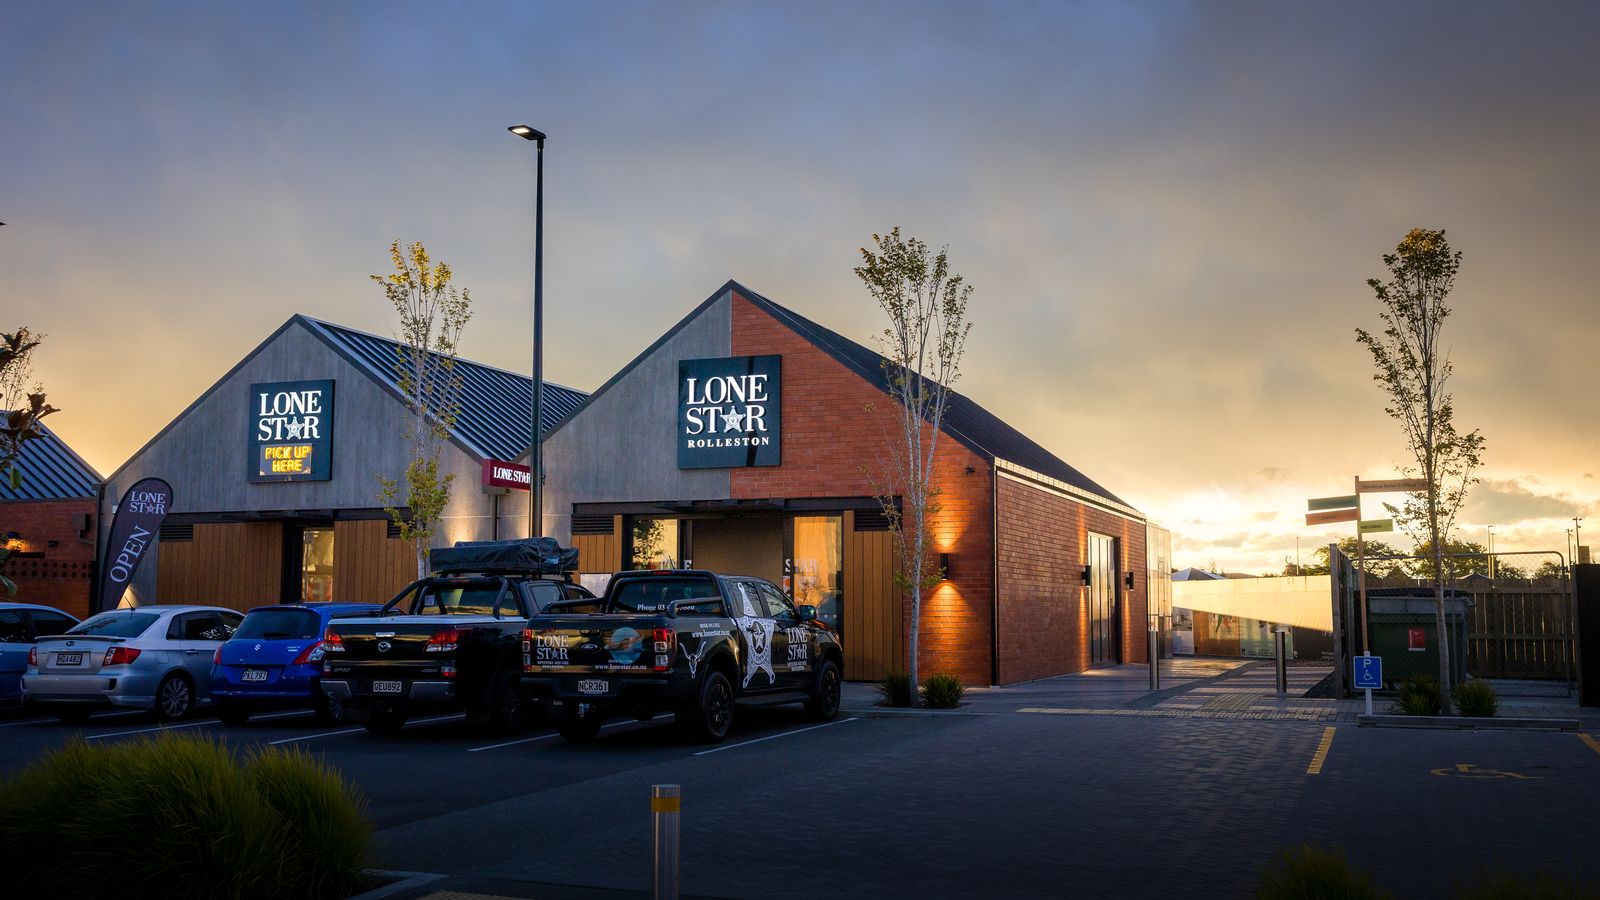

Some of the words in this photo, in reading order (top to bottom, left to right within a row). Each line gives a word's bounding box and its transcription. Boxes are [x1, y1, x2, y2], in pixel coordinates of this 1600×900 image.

[686, 374, 768, 405] LONE
[259, 390, 322, 416] LONE
[687, 437, 769, 448] ROLLESTON
[265, 446, 292, 460] PICK
[294, 446, 312, 458] UP
[272, 460, 303, 473] HERE
[493, 466, 513, 481] LONE
[131, 491, 165, 504] LONE
[110, 524, 151, 583] OPEN
[637, 603, 656, 612] Phone
[536, 635, 568, 648] LONE
[787, 627, 807, 644] LONE
[1363, 659, 1372, 669] P
[579, 681, 607, 690] NCR361
